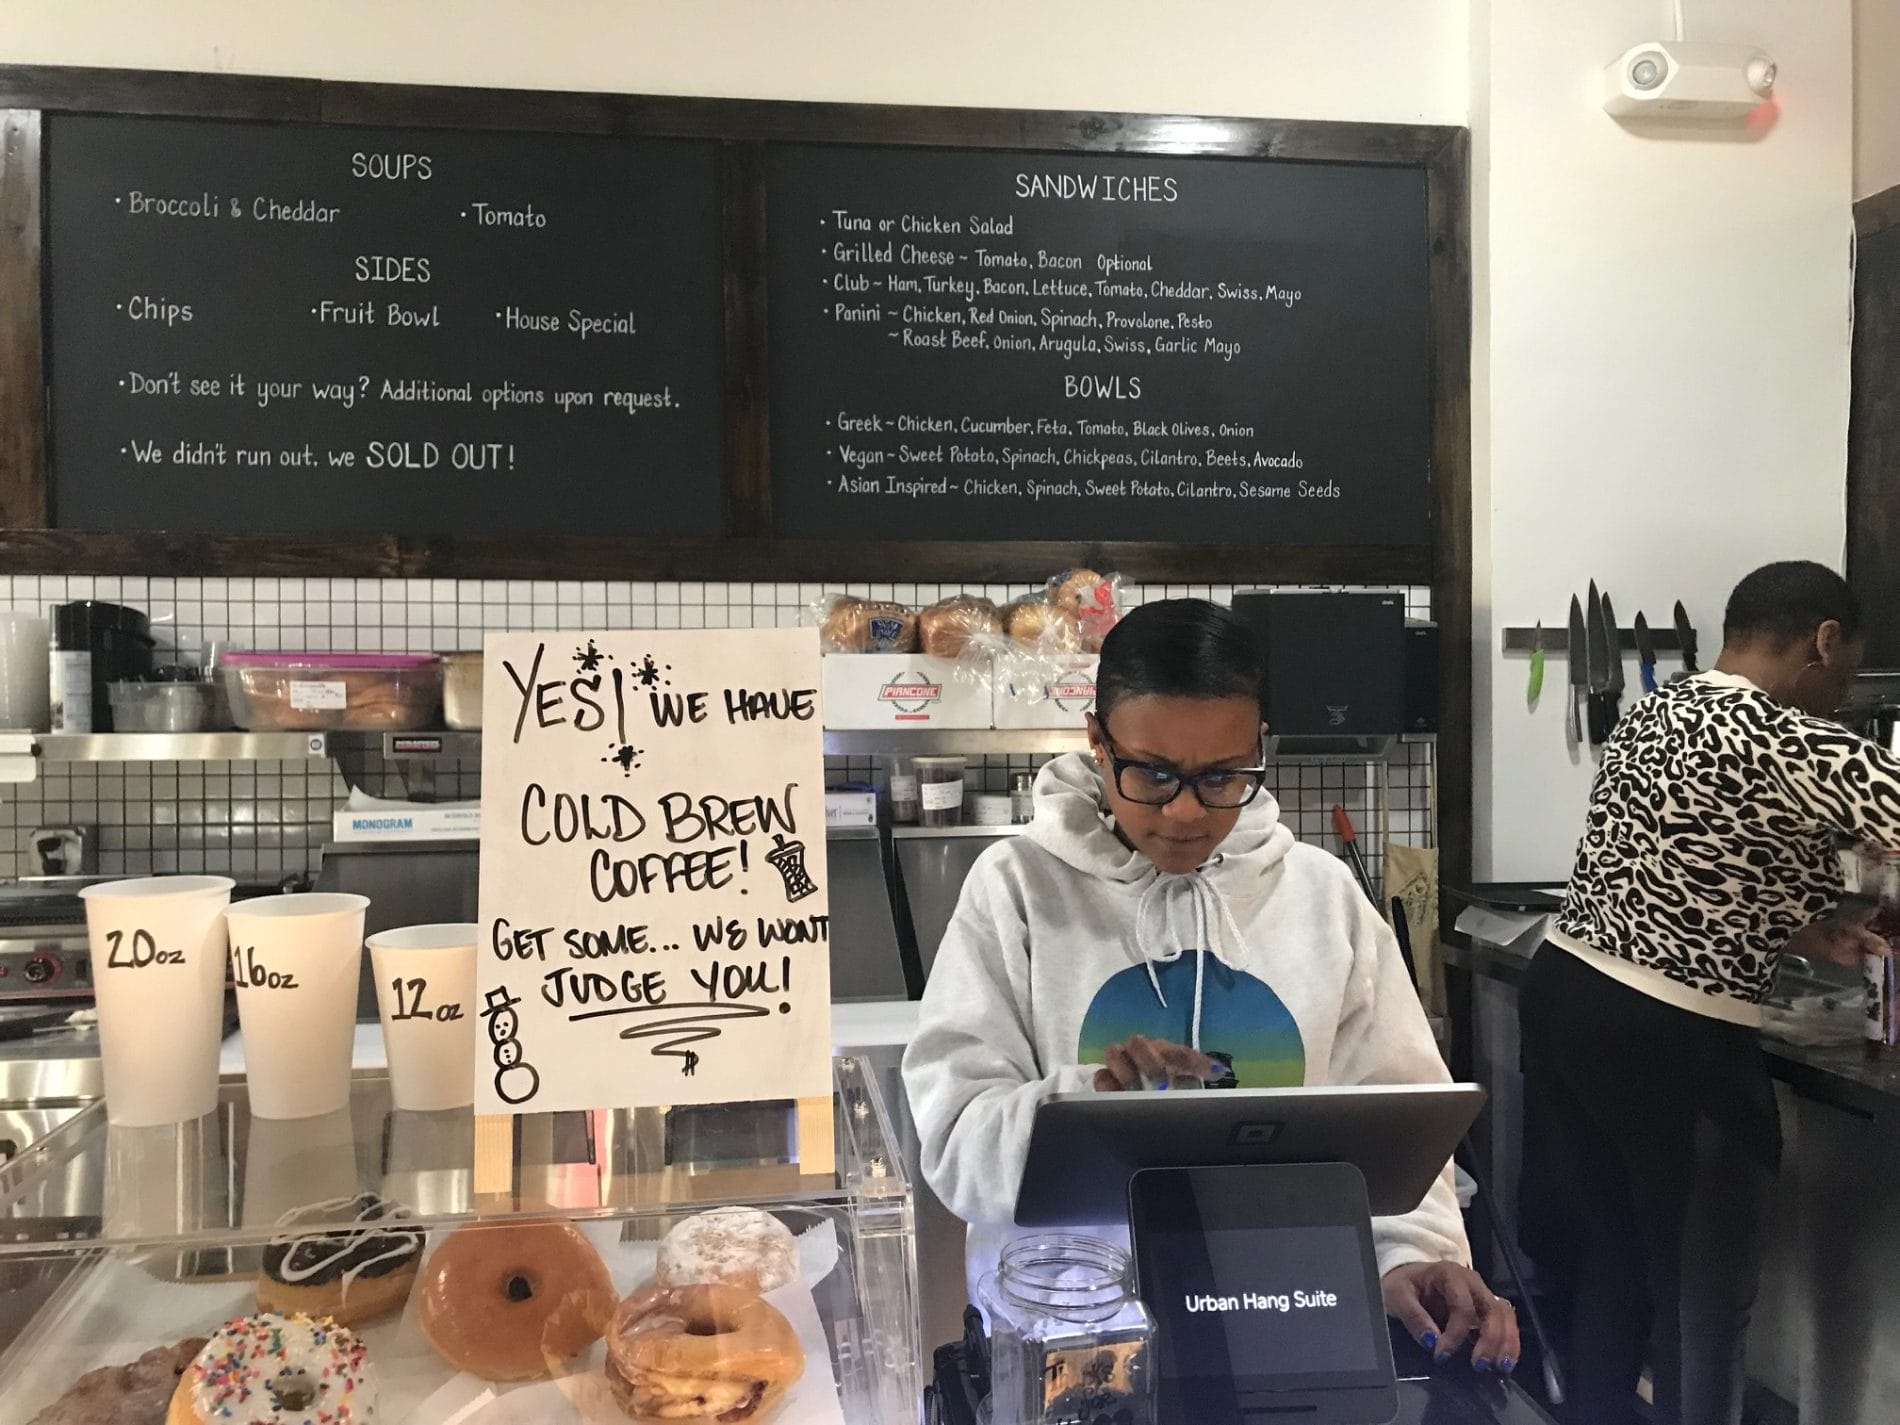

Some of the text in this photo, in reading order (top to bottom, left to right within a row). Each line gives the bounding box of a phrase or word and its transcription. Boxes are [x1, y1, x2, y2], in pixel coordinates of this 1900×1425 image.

[352, 153, 432, 180] SOUPS
[1015, 173, 1178, 202] SANDWICHES
[129, 191, 340, 222] Broccoli & Cheddar
[472, 203, 547, 228] Tomato
[832, 210, 1013, 235] Tuna or Chicken Salad
[355, 256, 431, 283] SIDES
[834, 241, 892, 263] Grilled
[900, 244, 954, 265] Cheese
[1038, 250, 1082, 269] Bacon
[1097, 254, 1153, 276] Optional
[834, 273, 869, 291] Club
[1265, 285, 1301, 308] Mayo
[128, 296, 193, 327] Chips
[321, 301, 440, 327] Fruit Bowl
[506, 306, 636, 339] House Special
[835, 303, 880, 321] Panini
[968, 307, 993, 324] Red
[1177, 312, 1213, 329] Pesto
[903, 328, 947, 347] Roast
[1155, 336, 1197, 353] Garlic
[1204, 337, 1241, 361] Mayo
[129, 371, 680, 415] Don't see it your way? Additional options upon request.
[1065, 375, 1141, 399] BOWLS
[838, 411, 883, 432] Greek
[1133, 420, 1169, 436] Black
[1219, 423, 1254, 437] Onion
[131, 440, 162, 463] We
[173, 441, 226, 465] didn't
[236, 450, 271, 466] run
[328, 450, 355, 466] we
[366, 441, 439, 468] SOLD
[451, 443, 514, 470] OUT!
[839, 444, 883, 469] Vegan
[899, 445, 944, 464] Sweet
[1253, 450, 1303, 469] Avocado
[838, 474, 880, 494] Asian
[885, 475, 947, 498] Inspired
[1085, 479, 1126, 496] Sweet
[1239, 481, 1291, 498] Sesame
[1298, 479, 1341, 498] Seeds
[883, 686, 938, 697] PIANCONE
[502, 642, 817, 771] YES! WE HAVE
[352, 818, 413, 830] MONOGRAM
[522, 783, 798, 845] COLD BREW
[591, 839, 748, 902] COFFEE!
[492, 918, 554, 961] GET
[693, 916, 747, 951] WE
[757, 915, 829, 948] WONT
[541, 956, 791, 1014] JUDGE YOU!
[1185, 1290, 1337, 1312] Urban Hang Suite
